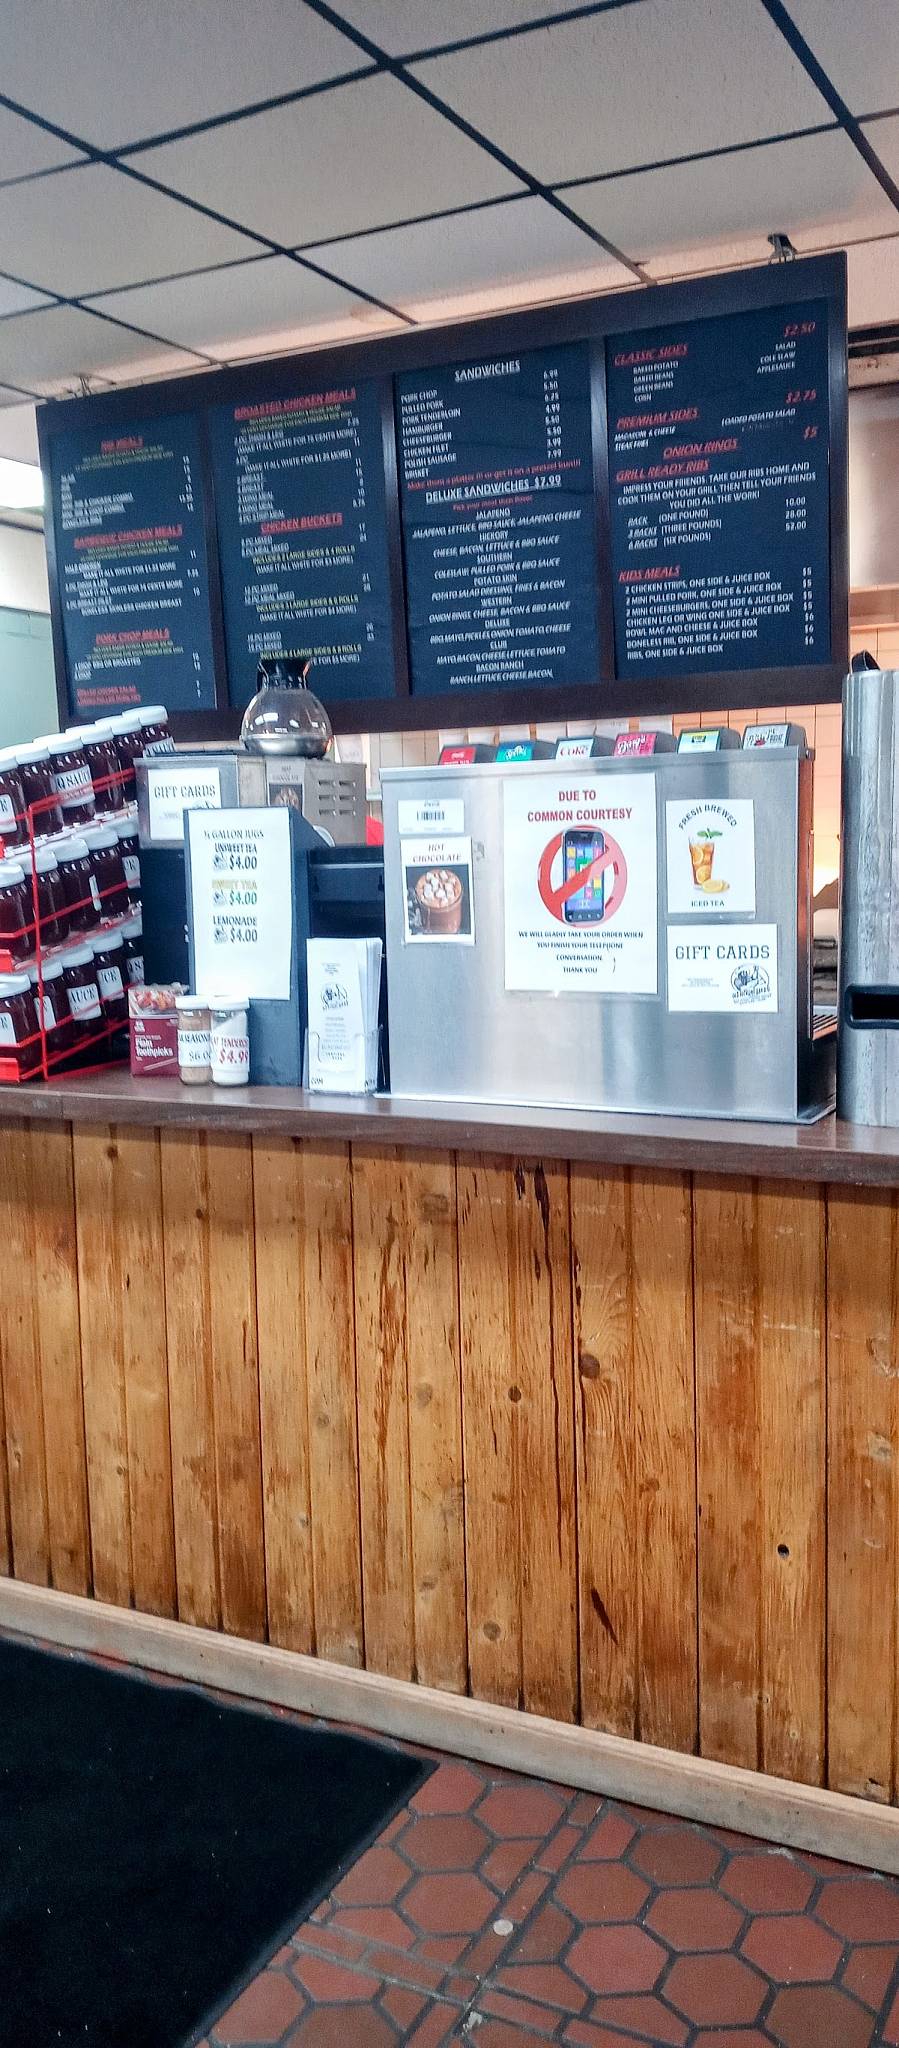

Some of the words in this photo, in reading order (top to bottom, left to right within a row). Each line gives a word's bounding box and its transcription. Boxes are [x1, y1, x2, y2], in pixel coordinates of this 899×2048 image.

[455, 360, 520, 382] SANDWICHES
[402, 402, 426, 415] PULLED
[427, 400, 443, 411] PORK
[402, 422, 443, 436] HAMBURGER
[403, 432, 452, 447] CHEESEBURGER
[405, 468, 429, 480] BRISKET
[624, 482, 651, 494] IMPRESS
[653, 479, 673, 491] YOUR
[709, 472, 728, 483] TAKE
[730, 470, 746, 481] OUR
[749, 468, 764, 478] RIBS
[766, 465, 789, 476] HOME
[792, 462, 810, 473] AND
[426, 487, 462, 504] DELUXE
[464, 479, 529, 499] SANDWICHES
[534, 475, 561, 489] $7.99
[618, 494, 639, 505] COOK
[640, 492, 660, 503] THEM
[662, 490, 673, 500] ON
[675, 487, 696, 498] YOUR
[720, 482, 740, 493] THEN
[742, 479, 758, 490] TELL
[760, 476, 782, 488] YOUR
[784, 472, 816, 485] FRIENDS
[670, 499, 687, 509] YOU
[688, 498, 700, 507] DID
[702, 496, 715, 505] ALL
[717, 494, 732, 504] THE
[480, 530, 508, 542] HICKORY
[477, 552, 512, 564] SOUTHERN
[619, 570, 642, 582] KIDS
[645, 565, 680, 579] MEALS
[631, 583, 662, 594] CHICKEN
[690, 578, 705, 588] ONE
[707, 576, 723, 586] SIDE
[725, 576, 730, 584] &
[732, 573, 752, 584] JUICE
[754, 571, 770, 581] BOX
[632, 595, 648, 605] MINI
[649, 592, 676, 603] PULLED
[700, 588, 716, 598] ONE
[718, 587, 734, 597] SIDE
[736, 586, 741, 595] &
[742, 584, 764, 595] JUICE
[766, 582, 781, 593] BOX
[627, 616, 658, 628] CHICKEN
[659, 615, 673, 625] LEG
[674, 614, 684, 623] OR
[686, 612, 707, 622] WING
[709, 610, 725, 620] ONE
[727, 608, 742, 619] SIDE
[744, 608, 749, 617] &
[751, 605, 772, 616] JUICE
[774, 604, 790, 614] BOX
[154, 785, 178, 799] GIFT
[181, 784, 216, 798] CARDS
[559, 790, 579, 801] DUE
[583, 790, 596, 801] TO
[528, 810, 573, 822] COMMON
[577, 808, 633, 821] COURTESY
[678, 806, 702, 830] FRESH
[704, 804, 737, 827] BREWED
[429, 843, 444, 852] HOT
[229, 855, 257, 870] $4.00
[413, 855, 462, 863] CHOCOLATE
[229, 891, 257, 905] $4.00
[213, 915, 257, 925] LEMONADE
[230, 929, 257, 943] $4.00
[675, 945, 711, 960] GIFT
[717, 945, 770, 959] CARDS
